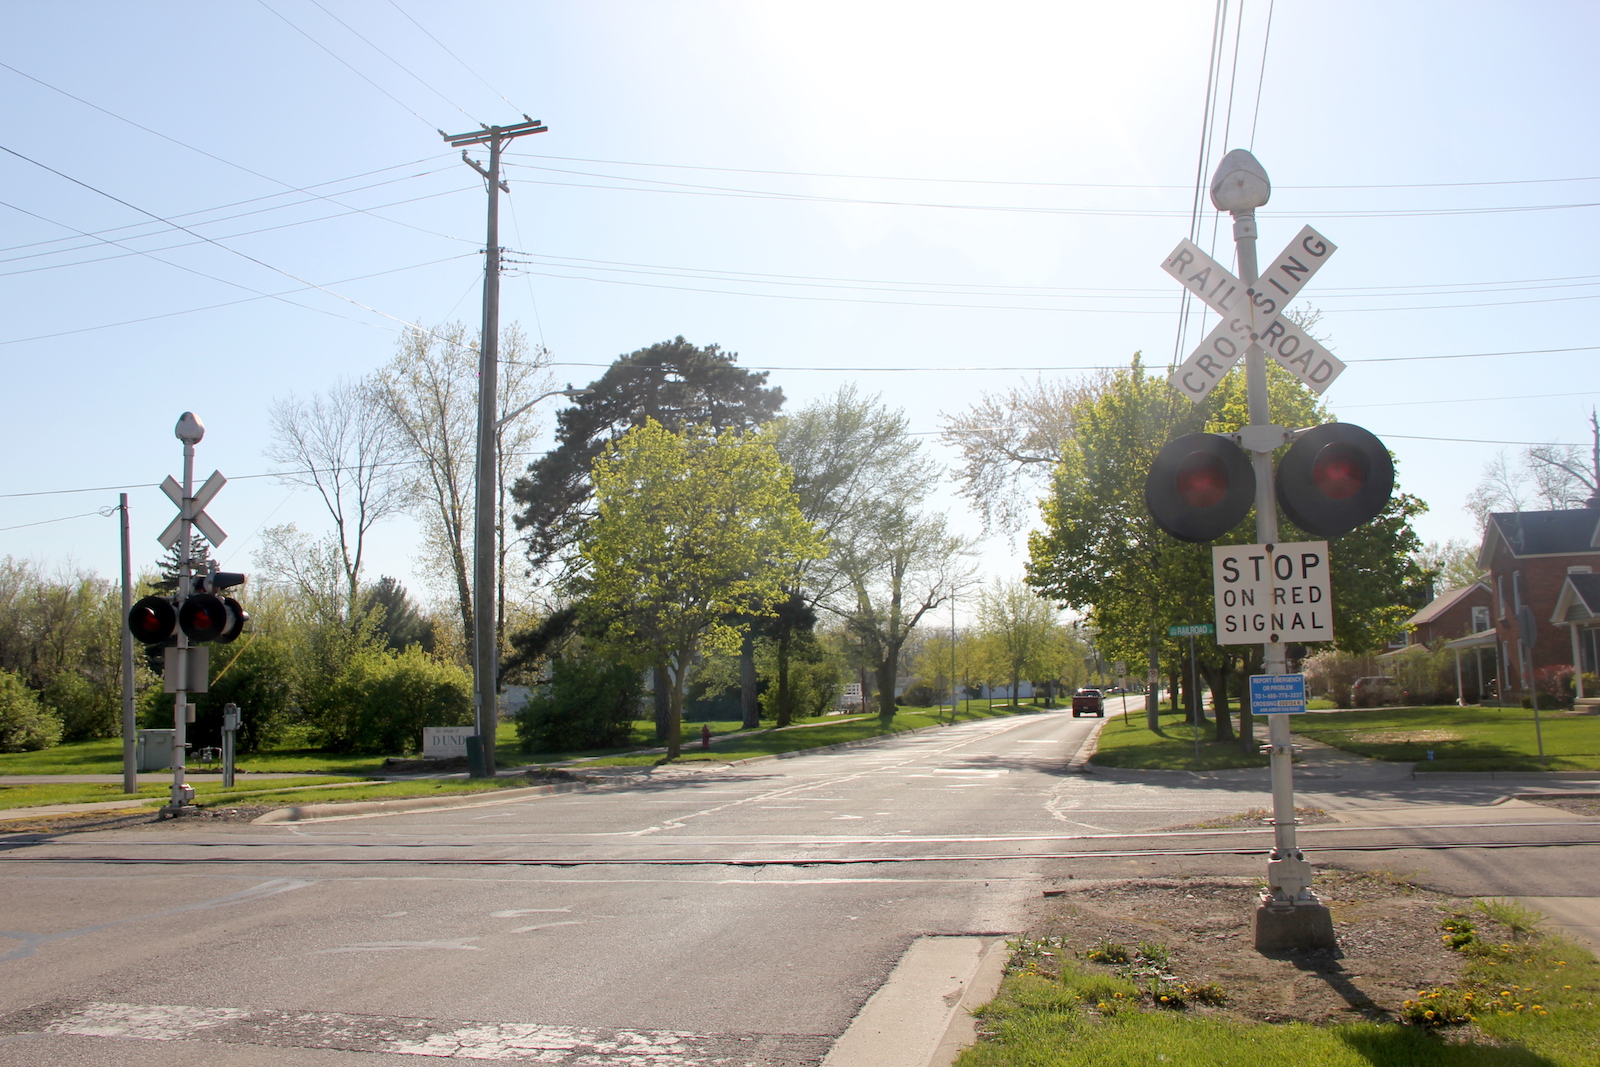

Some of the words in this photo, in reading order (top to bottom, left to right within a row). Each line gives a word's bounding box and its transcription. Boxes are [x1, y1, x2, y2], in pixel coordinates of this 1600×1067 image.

[1169, 247, 1236, 312] RAIL
[1260, 320, 1334, 384] ROAD
[1222, 553, 1320, 583] STOP
[1223, 588, 1254, 607] ON
[1273, 586, 1322, 605] RED
[1177, 625, 1208, 635] RAILROAD
[1225, 612, 1324, 632] SIGNAL
